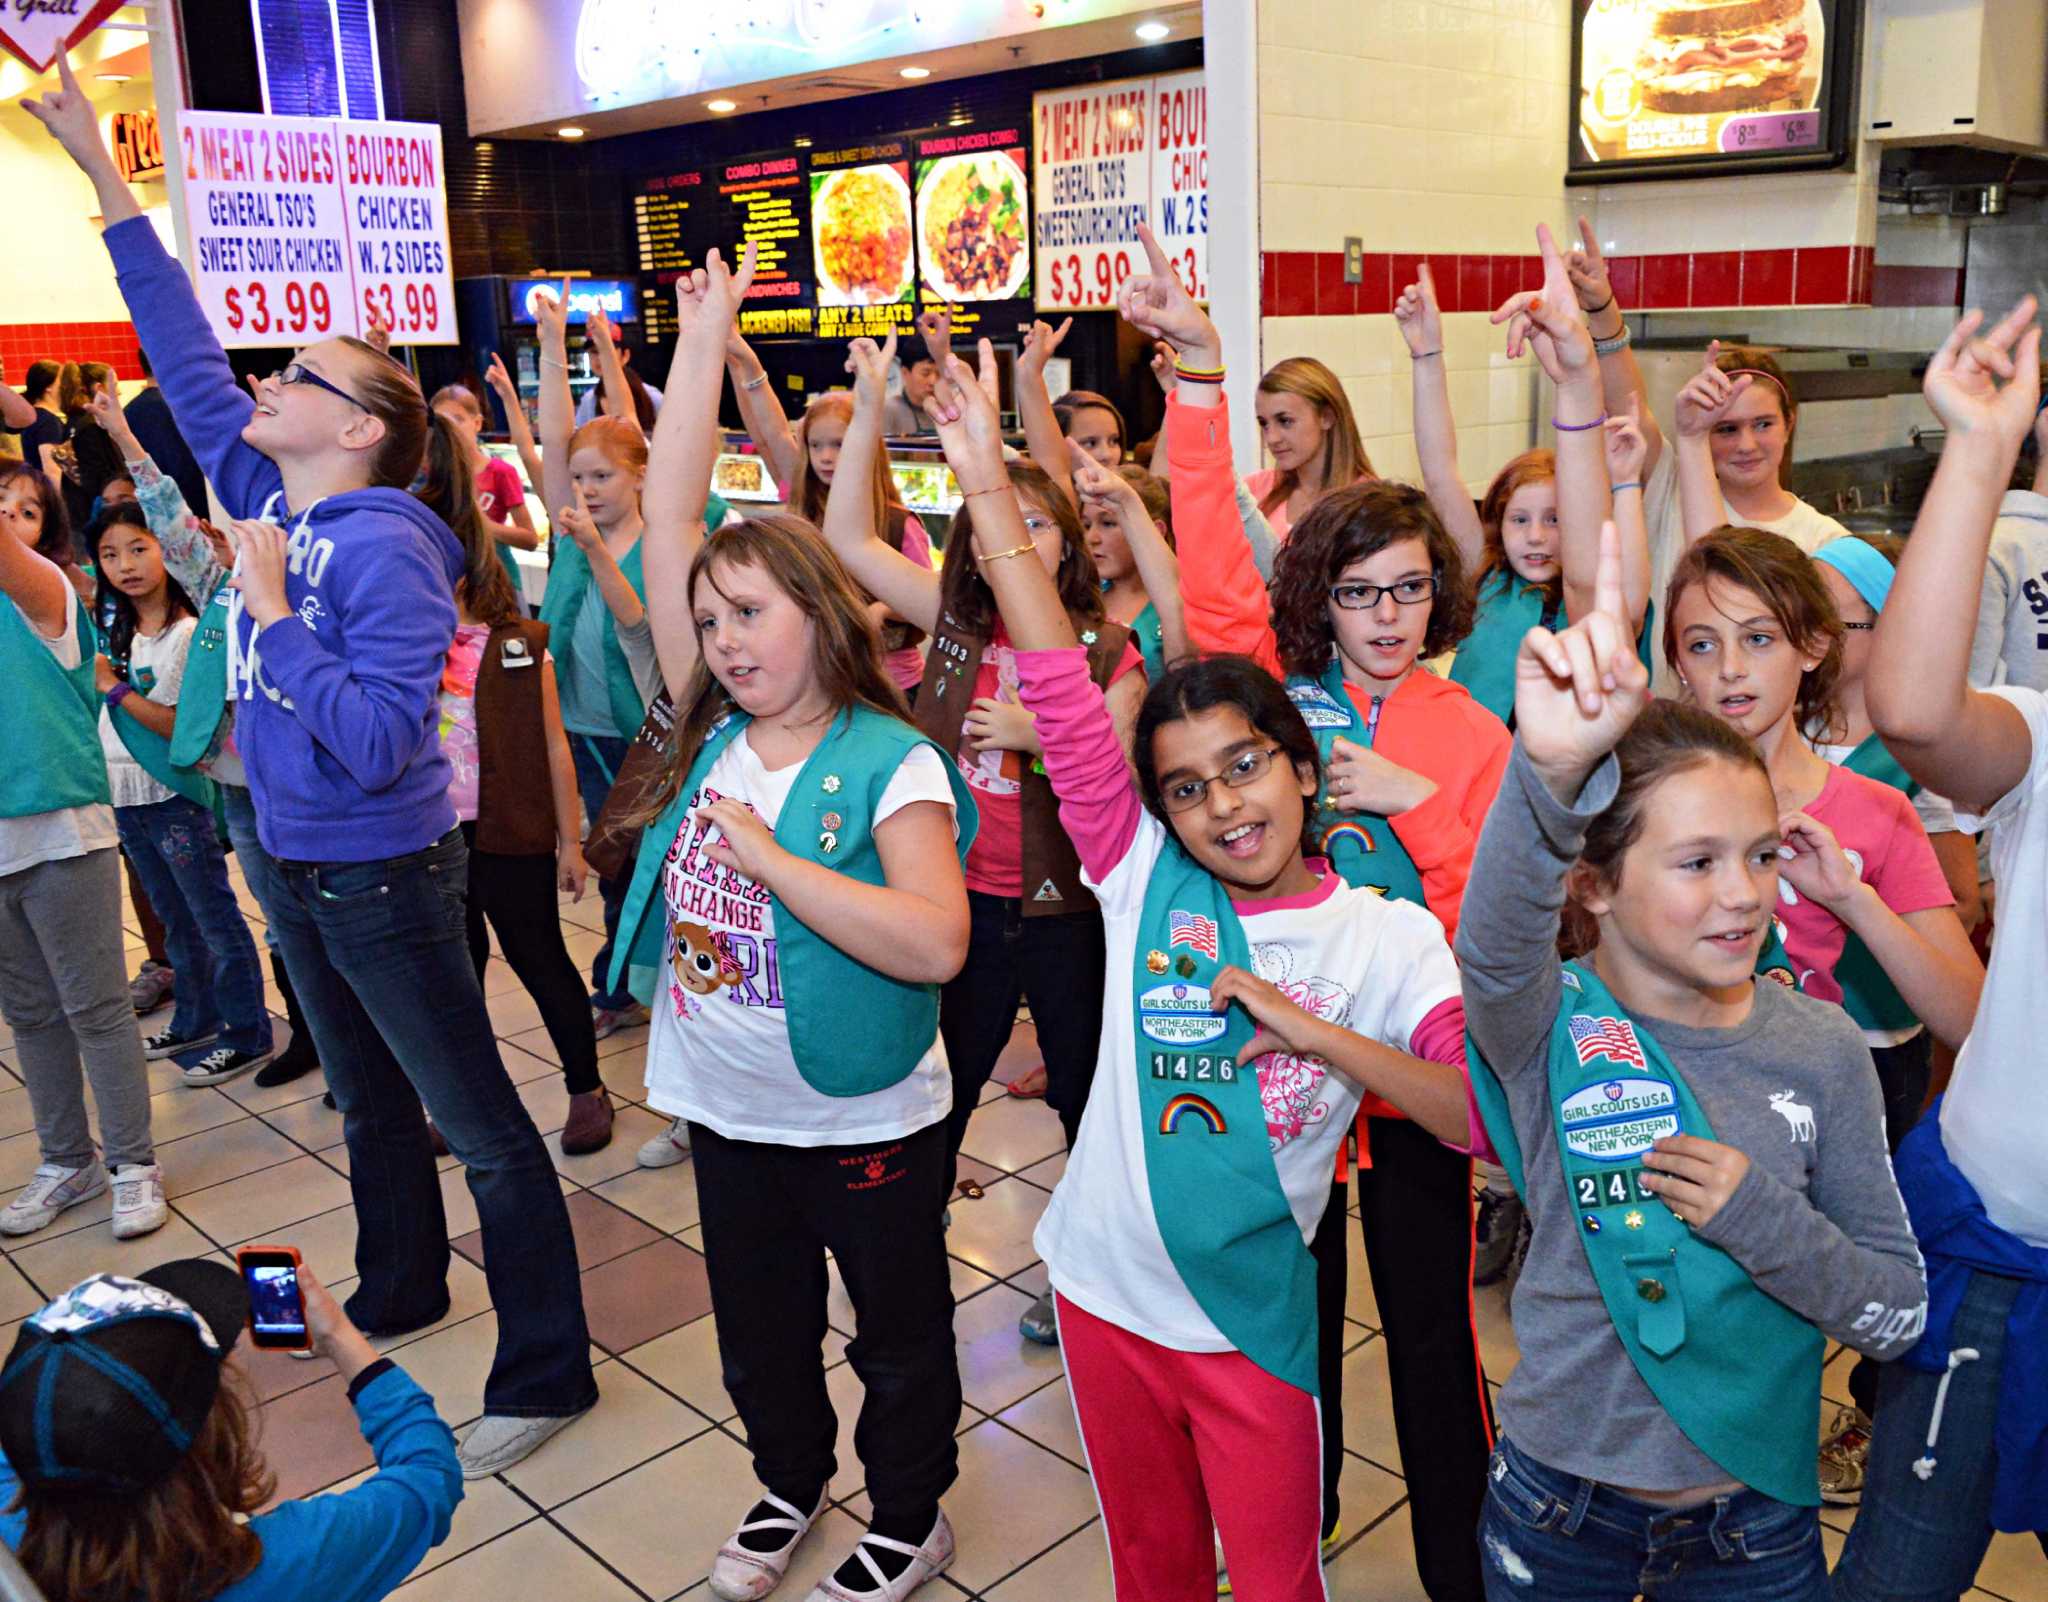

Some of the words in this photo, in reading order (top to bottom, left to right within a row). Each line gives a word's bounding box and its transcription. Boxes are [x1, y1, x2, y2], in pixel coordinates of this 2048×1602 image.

[1040, 104, 1050, 165] 2
[1053, 99, 1089, 163] MEAT
[1092, 96, 1101, 157] 2
[1104, 89, 1146, 156] SIDES
[183, 126, 197, 180] 2
[200, 128, 255, 182] MEAT
[260, 129, 274, 182] 2
[276, 130, 334, 184] SIDES
[346, 133, 435, 188] BOURBON
[1172, 150, 1208, 193] CHIC
[208, 190, 274, 227] GENERAL
[275, 192, 316, 228] TSO'S
[357, 194, 433, 231] CHICKEN
[1186, 194, 1196, 235] 2
[199, 236, 244, 273] SWEET
[247, 237, 285, 273] SOUR
[285, 238, 343, 273] CHICKEN
[357, 240, 379, 274] W.
[382, 240, 393, 274] 2
[396, 240, 444, 274] SIDES
[224, 280, 331, 335] $3.99
[364, 282, 439, 333] $3.99
[819, 307, 848, 324] ANY
[852, 306, 861, 323] 2
[863, 303, 913, 322] MEATS
[680, 878, 764, 932] CHANGE
[1145, 1017, 1223, 1029] NORTHEASTERN
[1161, 999, 1199, 1010] SCOUTS
[1200, 1000, 1214, 1010] US
[1155, 1026, 1177, 1037] NEW
[1180, 1027, 1207, 1038] YORK
[1563, 1107, 1591, 1121] GIRL
[1592, 1096, 1640, 1115] SCOUTS
[1642, 1091, 1669, 1108] USA
[1569, 1117, 1673, 1144] NORTHEASTERN
[1588, 1138, 1618, 1153] NEW
[1620, 1132, 1656, 1148] YORK
